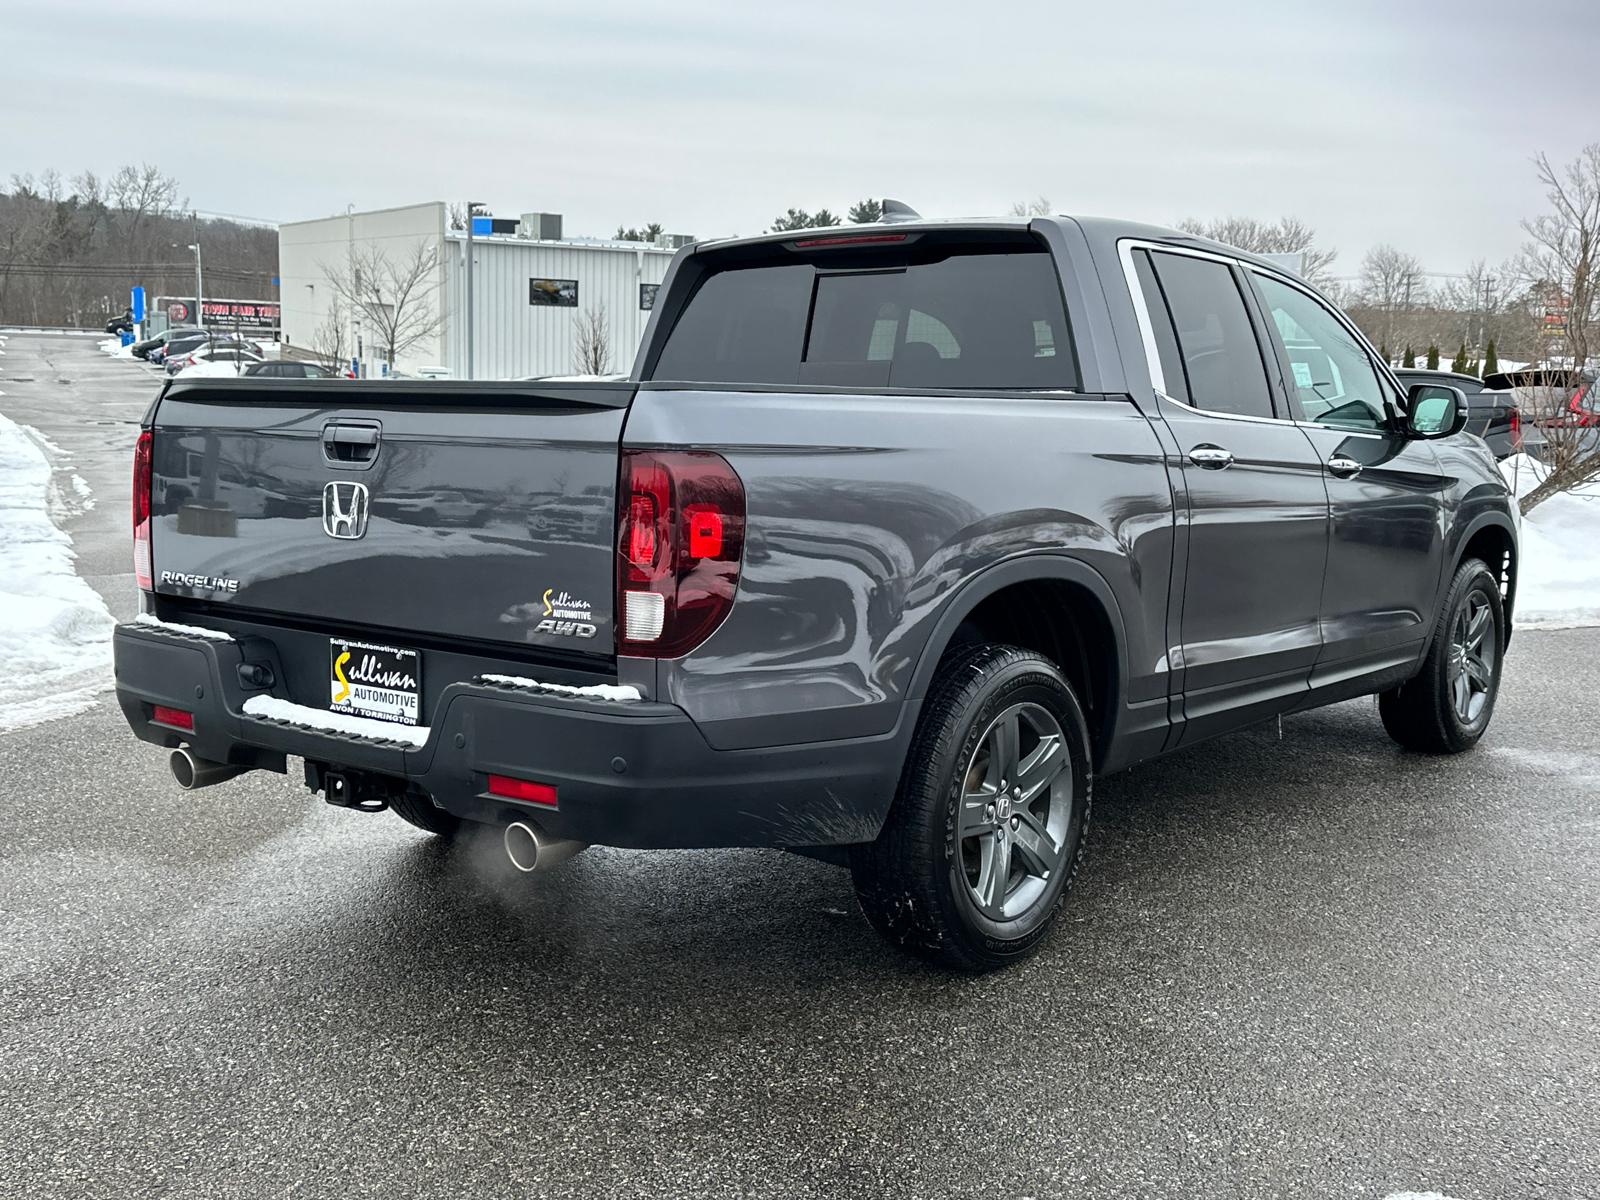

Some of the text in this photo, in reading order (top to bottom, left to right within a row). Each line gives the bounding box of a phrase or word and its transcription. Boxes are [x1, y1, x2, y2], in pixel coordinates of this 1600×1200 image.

[202, 303, 280, 317] TOWN FAIR TIRE
[161, 570, 239, 593] RIDGELINE
[542, 588, 591, 616] Sullivan
[553, 609, 591, 620] AUTOMOTIVE
[534, 619, 597, 638] AWD
[330, 638, 416, 657] SullivanAutomotive.com
[334, 652, 416, 702] Sullivan
[354, 688, 416, 708] AUTOMOTIVE
[329, 703, 354, 714] AVON
[360, 709, 416, 725] TORRINGTON
